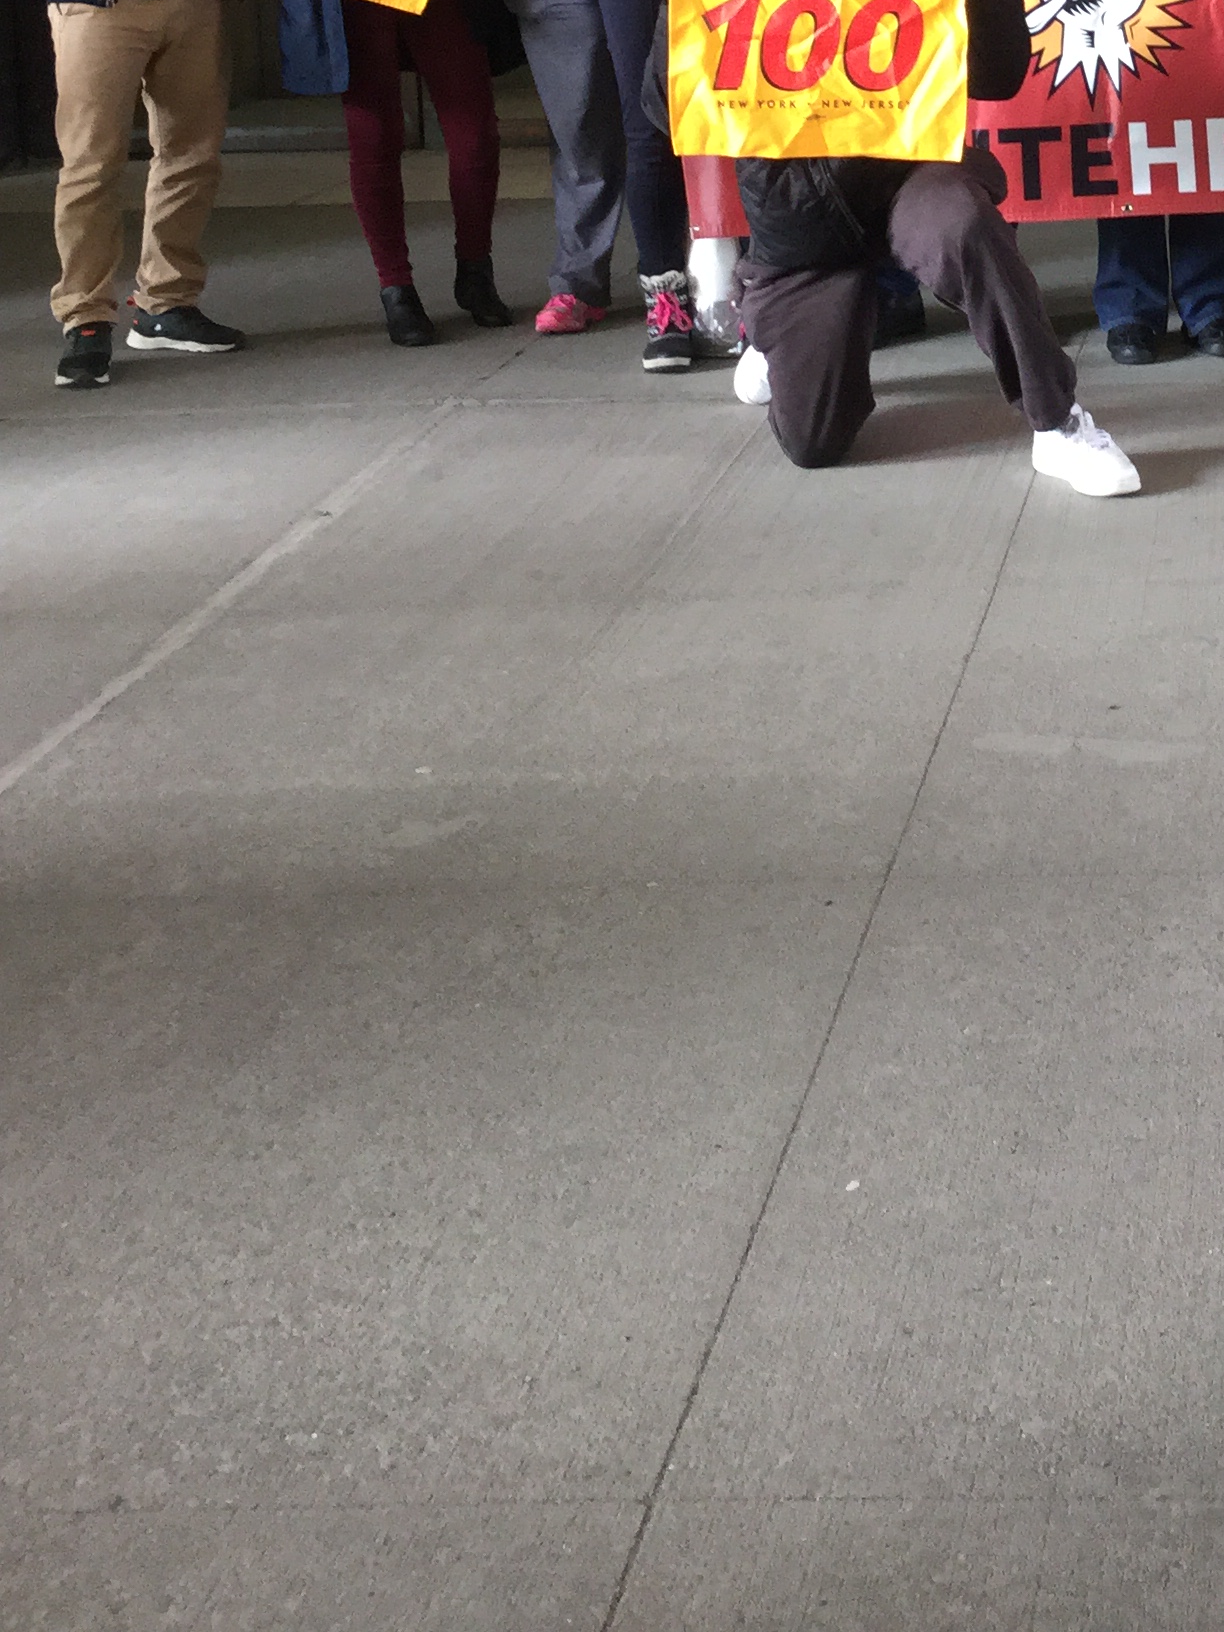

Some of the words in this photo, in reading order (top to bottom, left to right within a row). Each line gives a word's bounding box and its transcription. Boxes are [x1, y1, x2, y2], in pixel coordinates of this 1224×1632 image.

[717, 99, 749, 109] NEW
[757, 99, 797, 109] YORK
[821, 99, 852, 109] NEW
